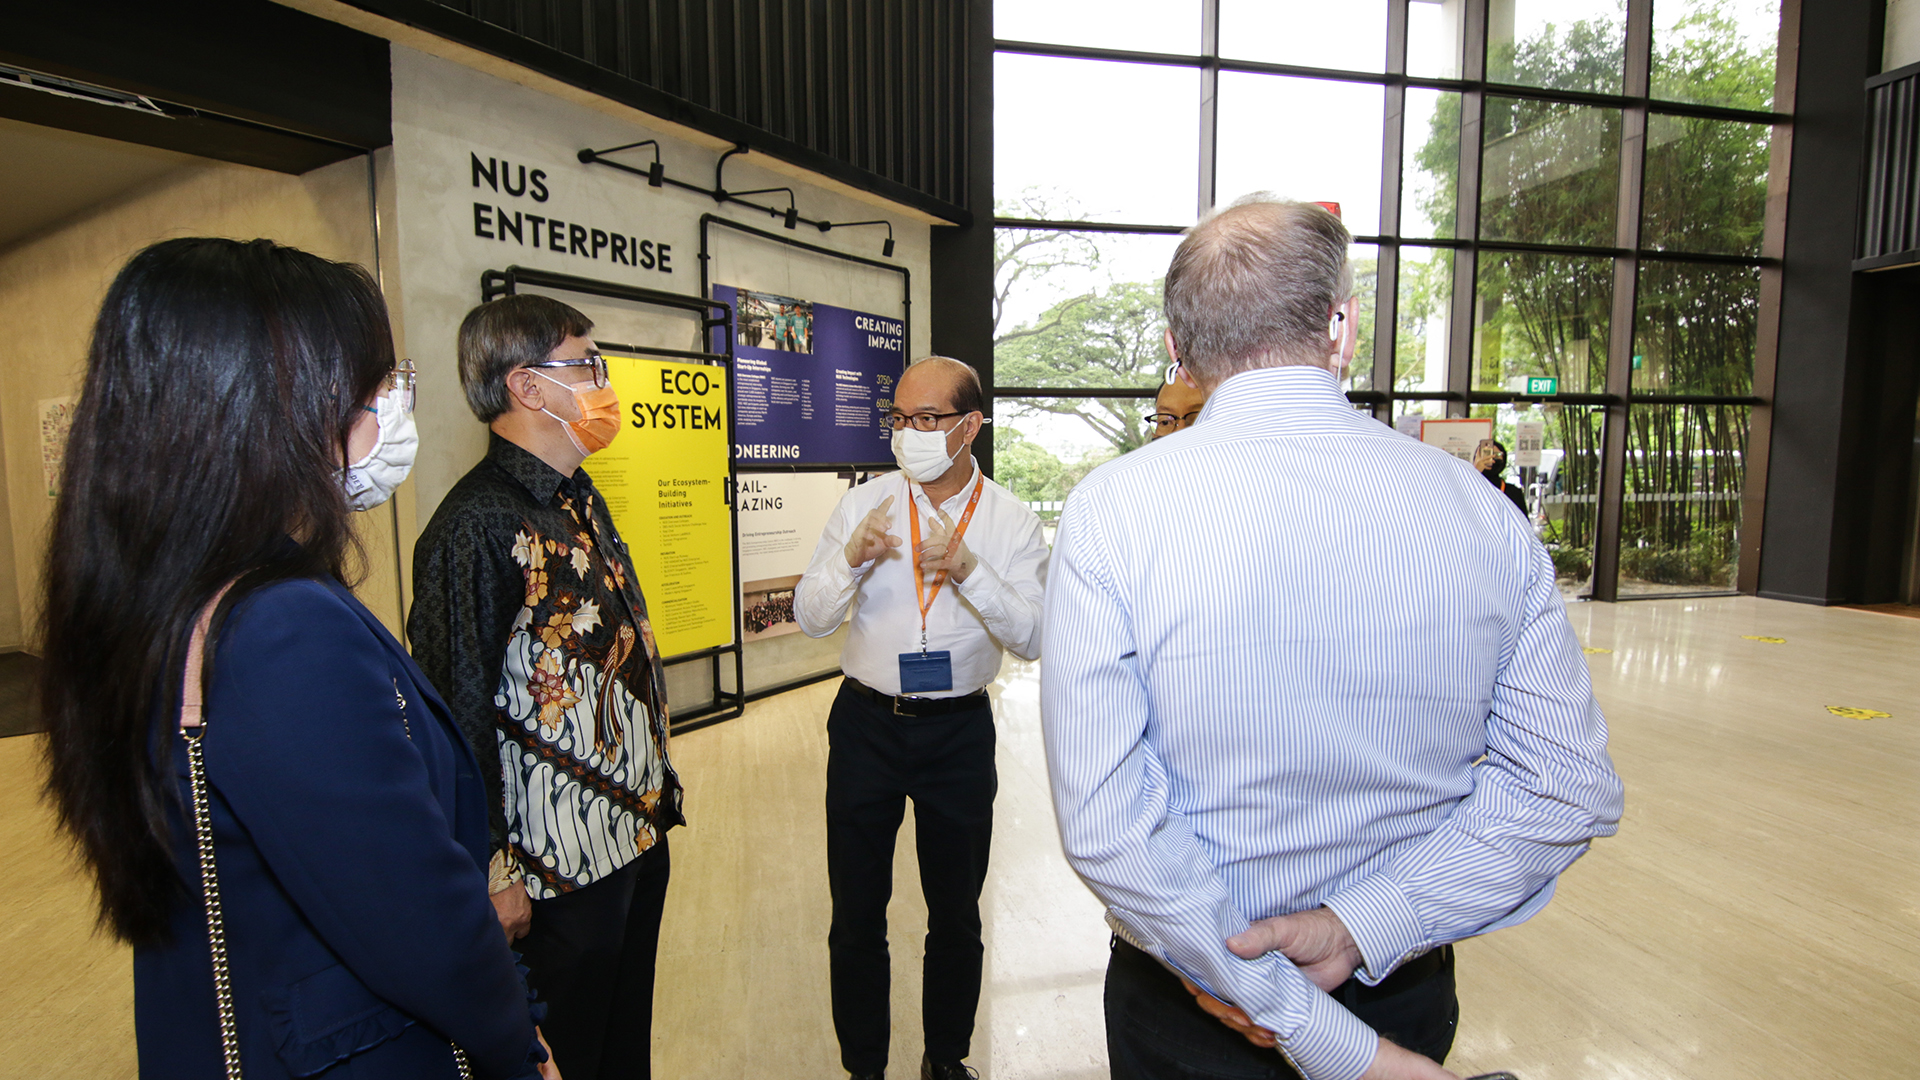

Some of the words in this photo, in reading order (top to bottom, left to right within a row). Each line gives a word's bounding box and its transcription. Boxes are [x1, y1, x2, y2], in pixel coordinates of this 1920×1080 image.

[471, 151, 549, 202] NUS
[473, 202, 672, 273] ENTERPRISE
[855, 316, 902, 337] CREATING
[868, 334, 902, 352] IMPACT
[661, 369, 720, 396] ECO-
[876, 374, 893, 385] 3750+
[1531, 379, 1553, 393] EXIT
[876, 398, 893, 409] 6000+
[631, 402, 722, 431] SYSTEM
[658, 479, 670, 487] Our
[673, 478, 711, 487] Ecosystem-
[658, 490, 687, 498] Building
[658, 500, 692, 508] Initiatives
